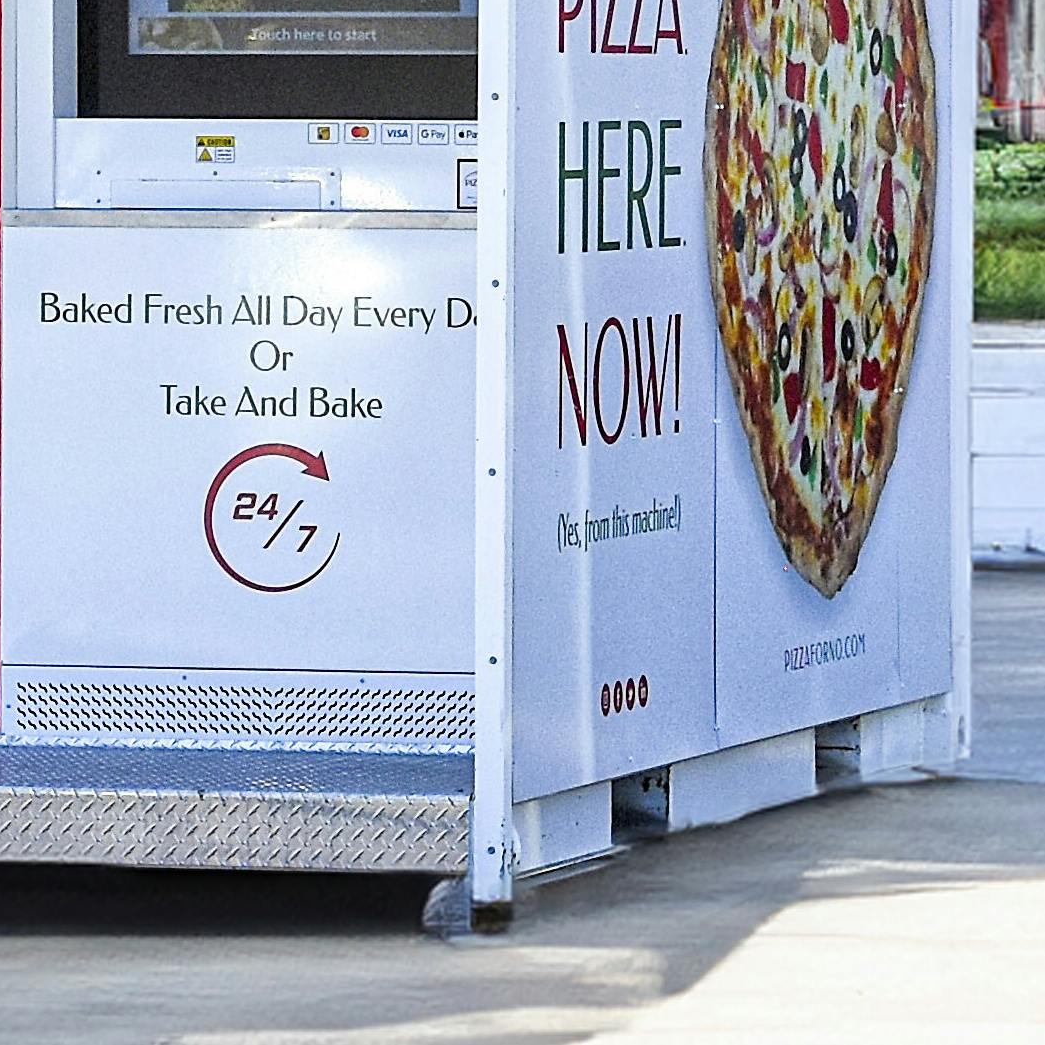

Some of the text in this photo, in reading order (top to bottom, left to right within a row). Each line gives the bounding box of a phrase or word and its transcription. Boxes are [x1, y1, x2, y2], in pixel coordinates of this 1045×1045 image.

[249, 28, 377, 41] Touch here to start
[387, 129, 408, 138] VISA
[431, 130, 446, 140] Pay
[40, 292, 132, 324] Baked
[144, 293, 222, 325] Fresh
[232, 295, 271, 326] All
[283, 295, 343, 333] Day
[353, 296, 437, 335] Every
[249, 340, 294, 372] Or
[556, 314, 682, 450] NOW!
[159, 384, 384, 419] Take And Bake
[232, 493, 319, 553] 24/7
[558, 493, 682, 553] (Yes, from this machine!)
[784, 633, 866, 672] PIZZAFORNO.COM
